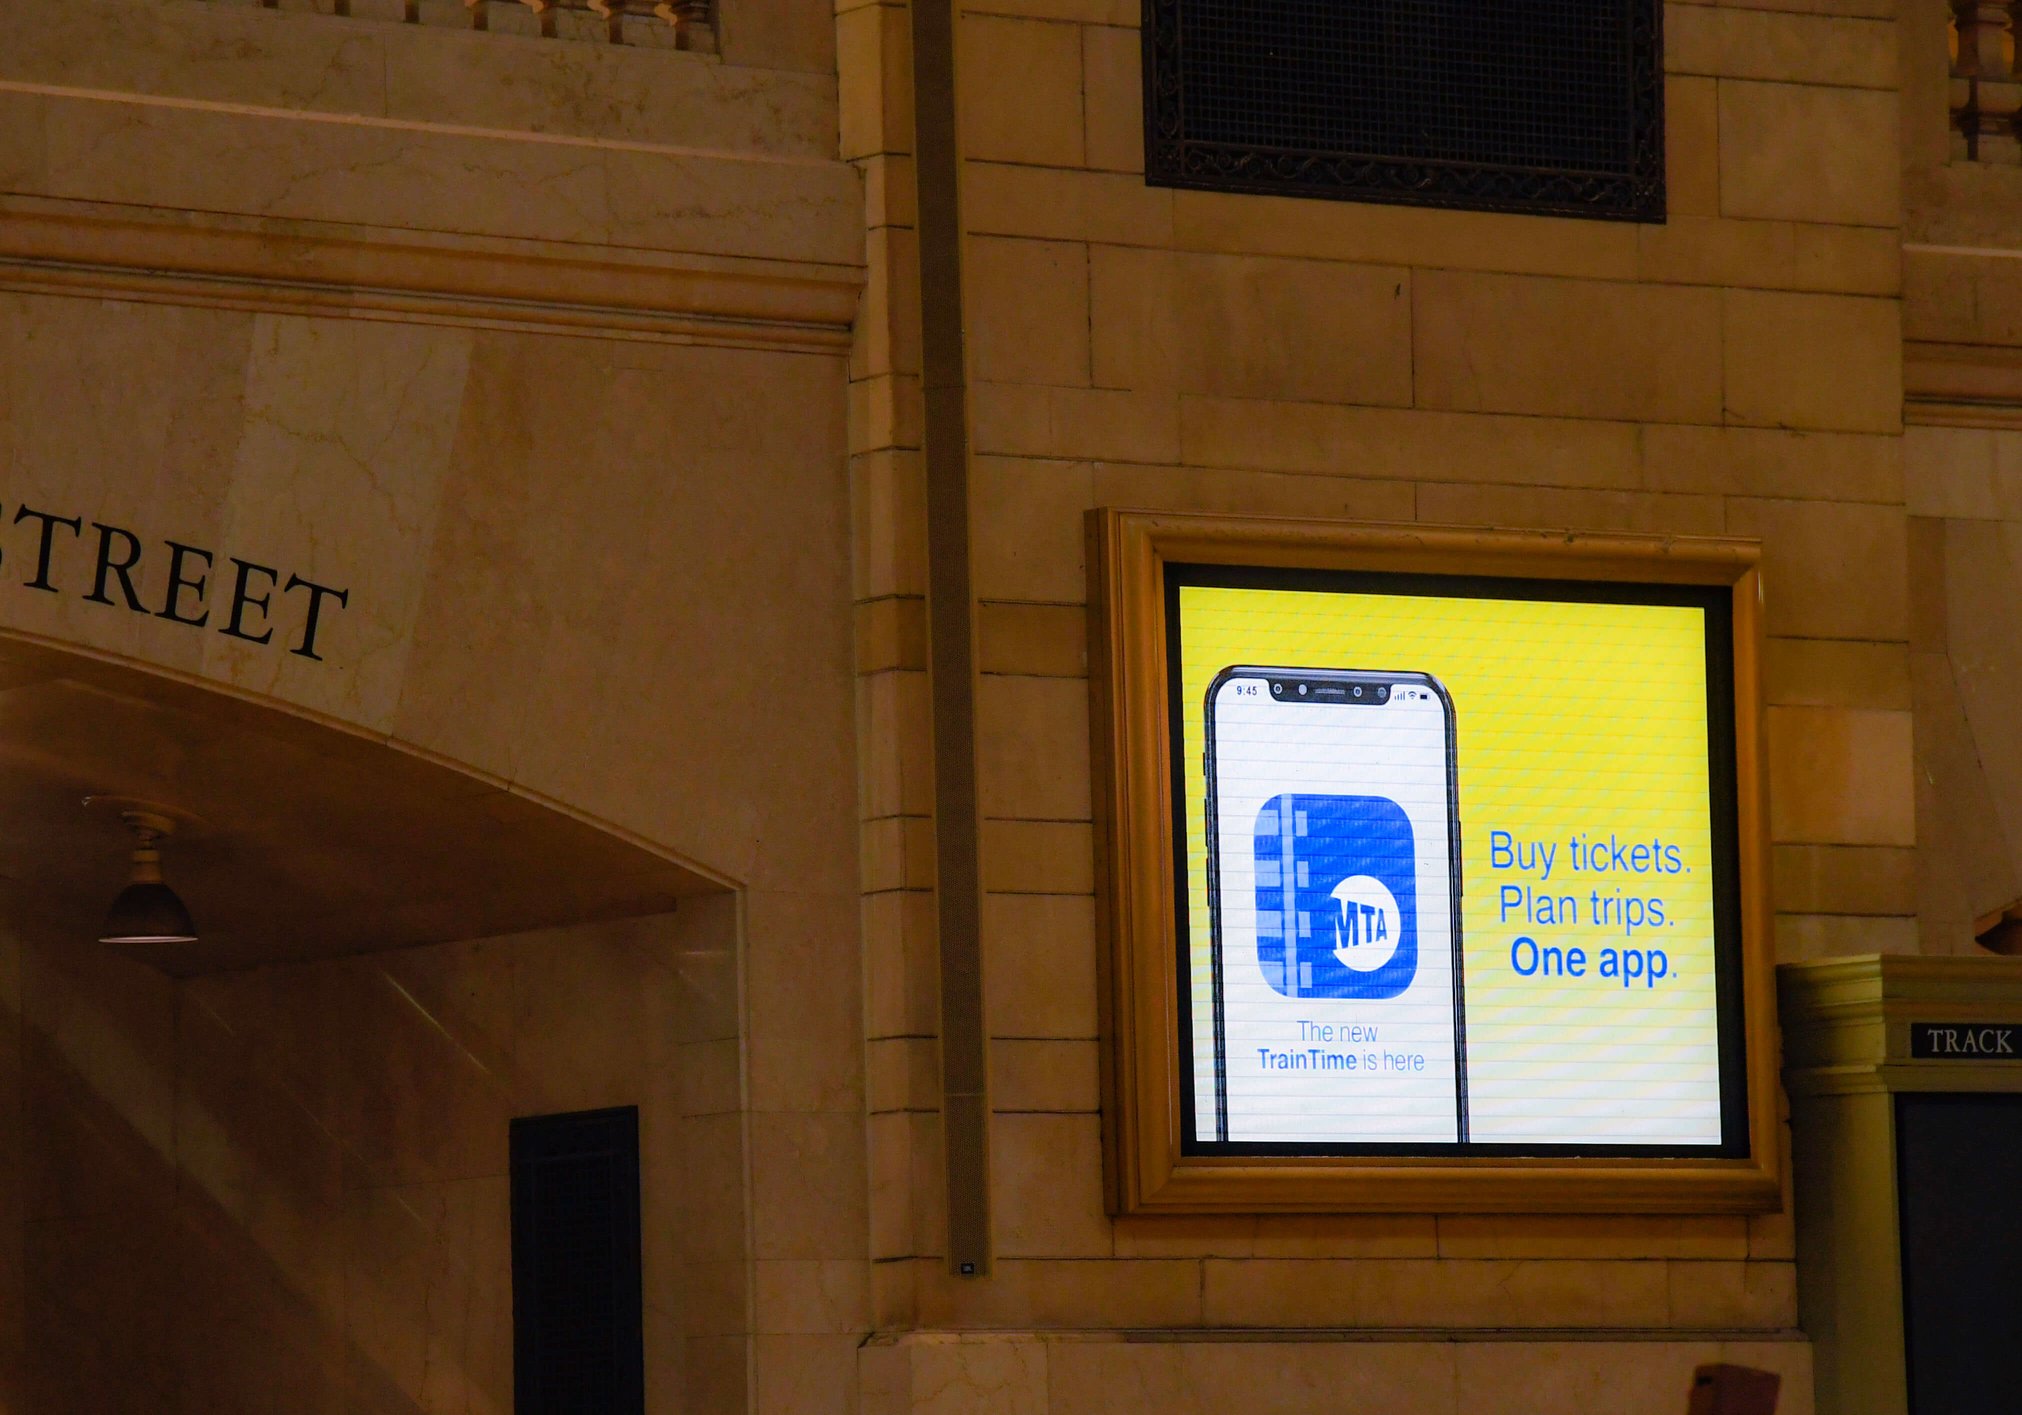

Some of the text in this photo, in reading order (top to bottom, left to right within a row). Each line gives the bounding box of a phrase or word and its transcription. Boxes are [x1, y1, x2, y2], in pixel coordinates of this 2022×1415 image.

[0, 502, 349, 661] TREET
[1236, 684, 1258, 697] 9:45
[1490, 830, 1691, 880] Buy tickets.
[1333, 899, 1388, 950] MTA
[1500, 885, 1674, 936] Plan trips.
[1510, 936, 1678, 988] One app.
[1296, 1020, 1379, 1043] The new
[1926, 1028, 2014, 1054] TRACK
[1257, 1048, 1425, 1071] TrainTime is here
